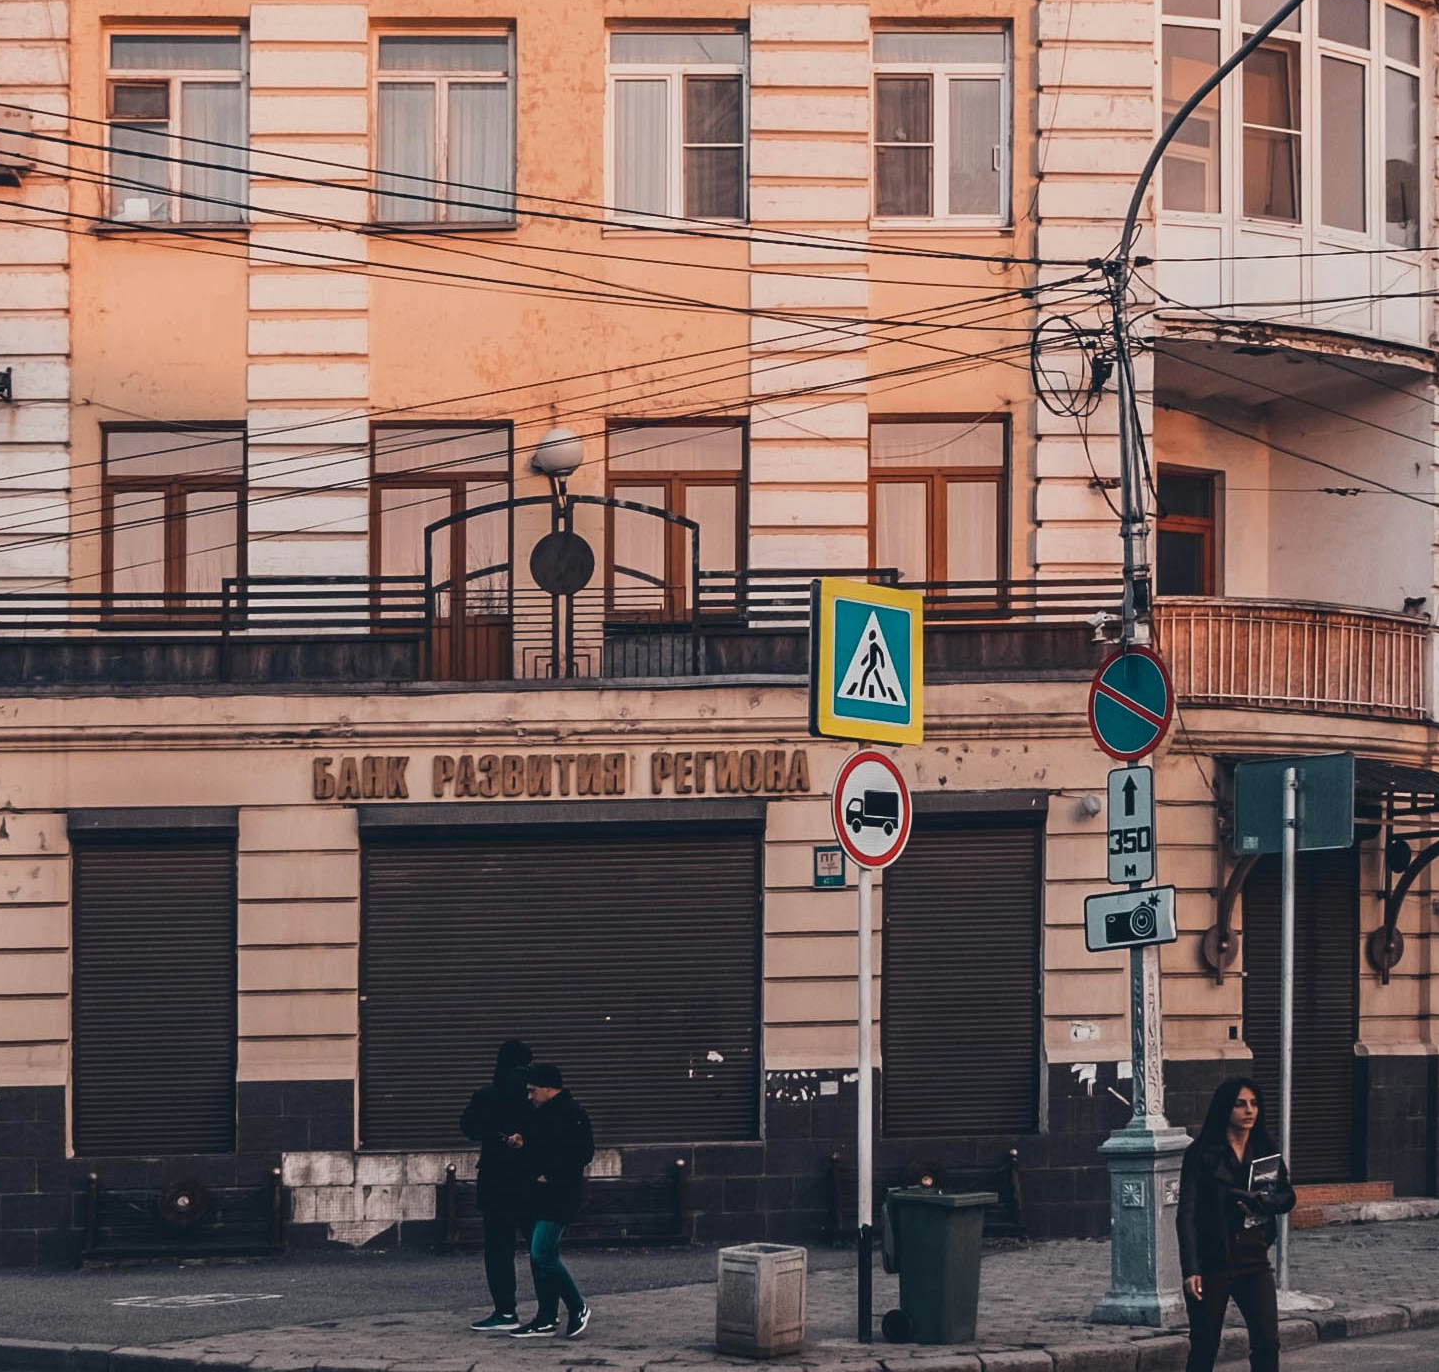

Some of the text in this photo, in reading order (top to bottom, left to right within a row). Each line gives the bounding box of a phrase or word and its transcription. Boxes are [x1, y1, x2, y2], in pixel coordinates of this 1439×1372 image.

[312, 749, 811, 799] БАНК РАЗВИТИЯ РЕГИОНА
[1109, 826, 1151, 855] 350
